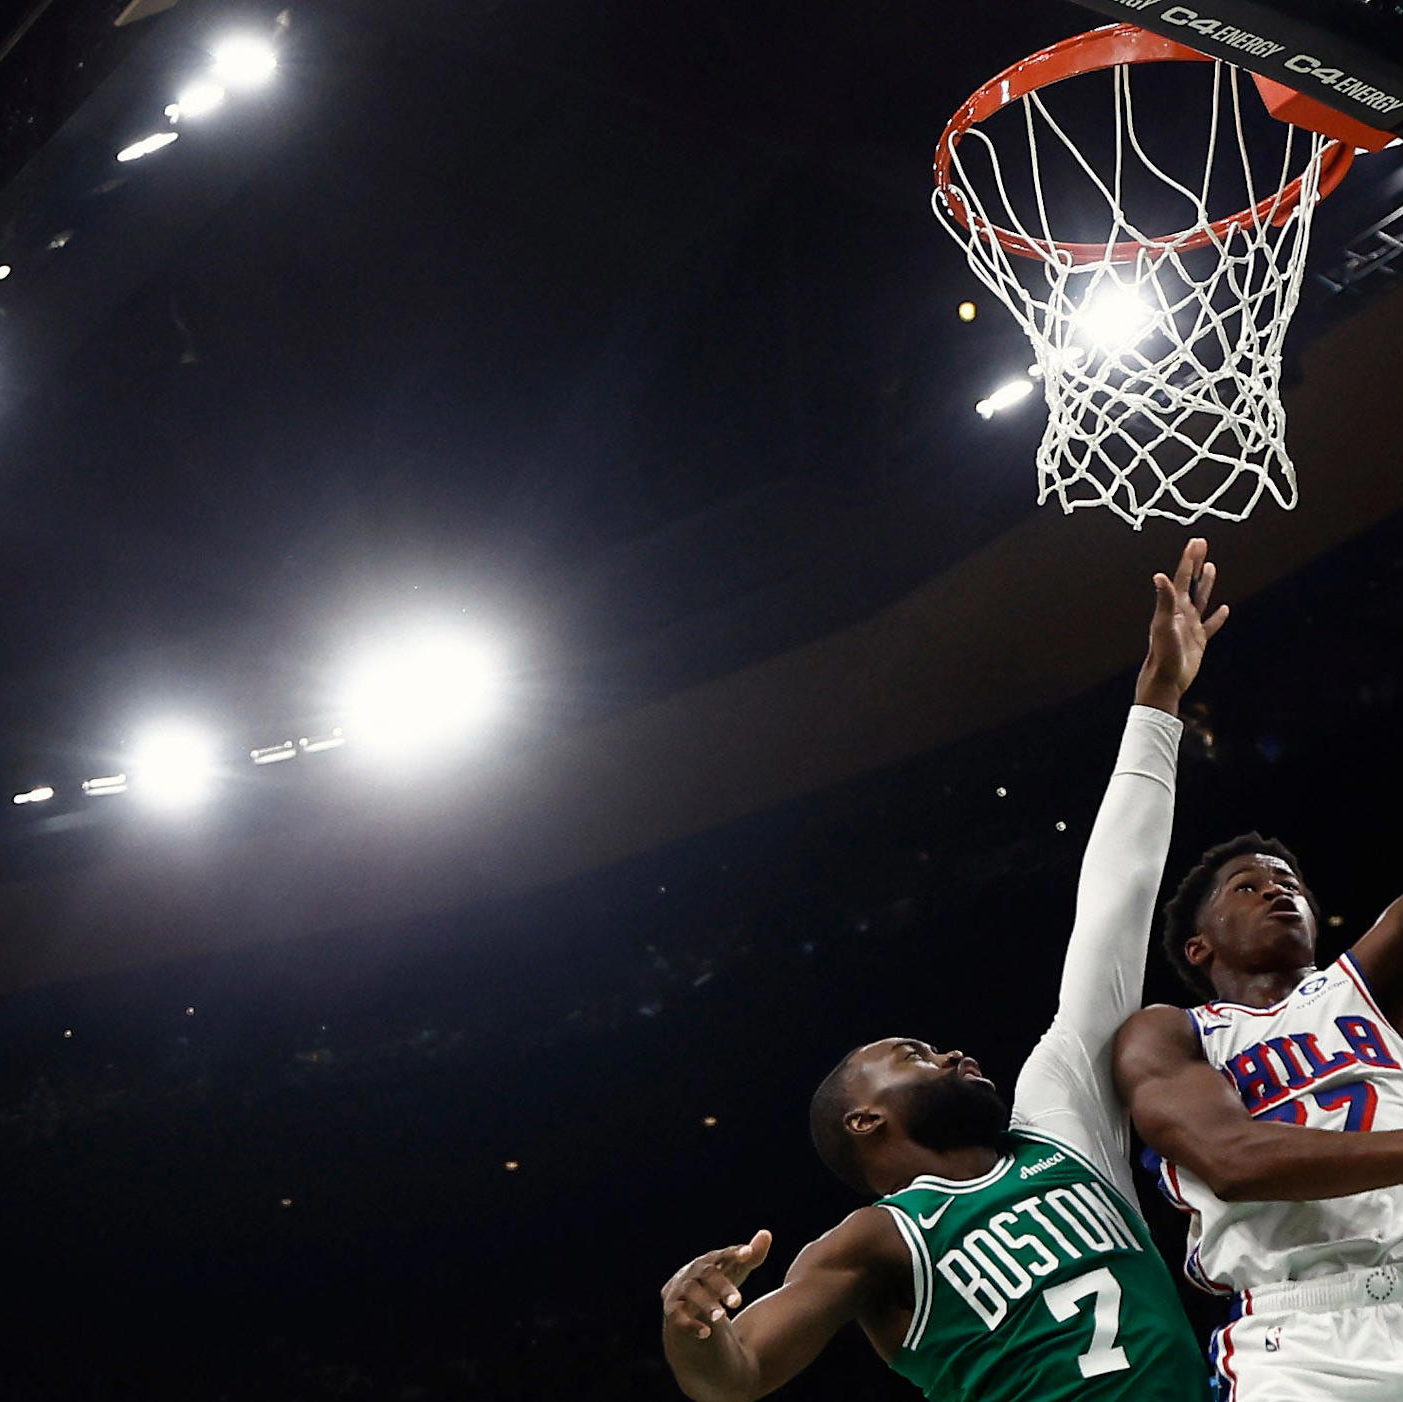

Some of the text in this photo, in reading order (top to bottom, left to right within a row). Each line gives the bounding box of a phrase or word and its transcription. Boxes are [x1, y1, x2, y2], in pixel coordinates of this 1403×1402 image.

[1159, 6, 1286, 60] C4 ENERGY
[1284, 54, 1348, 86] C4
[1221, 1015, 1402, 1118] HILA
[1019, 1150, 1066, 1180] Amica
[935, 1180, 1143, 1331] BOSTON
[1043, 1266, 1131, 1379] 7
